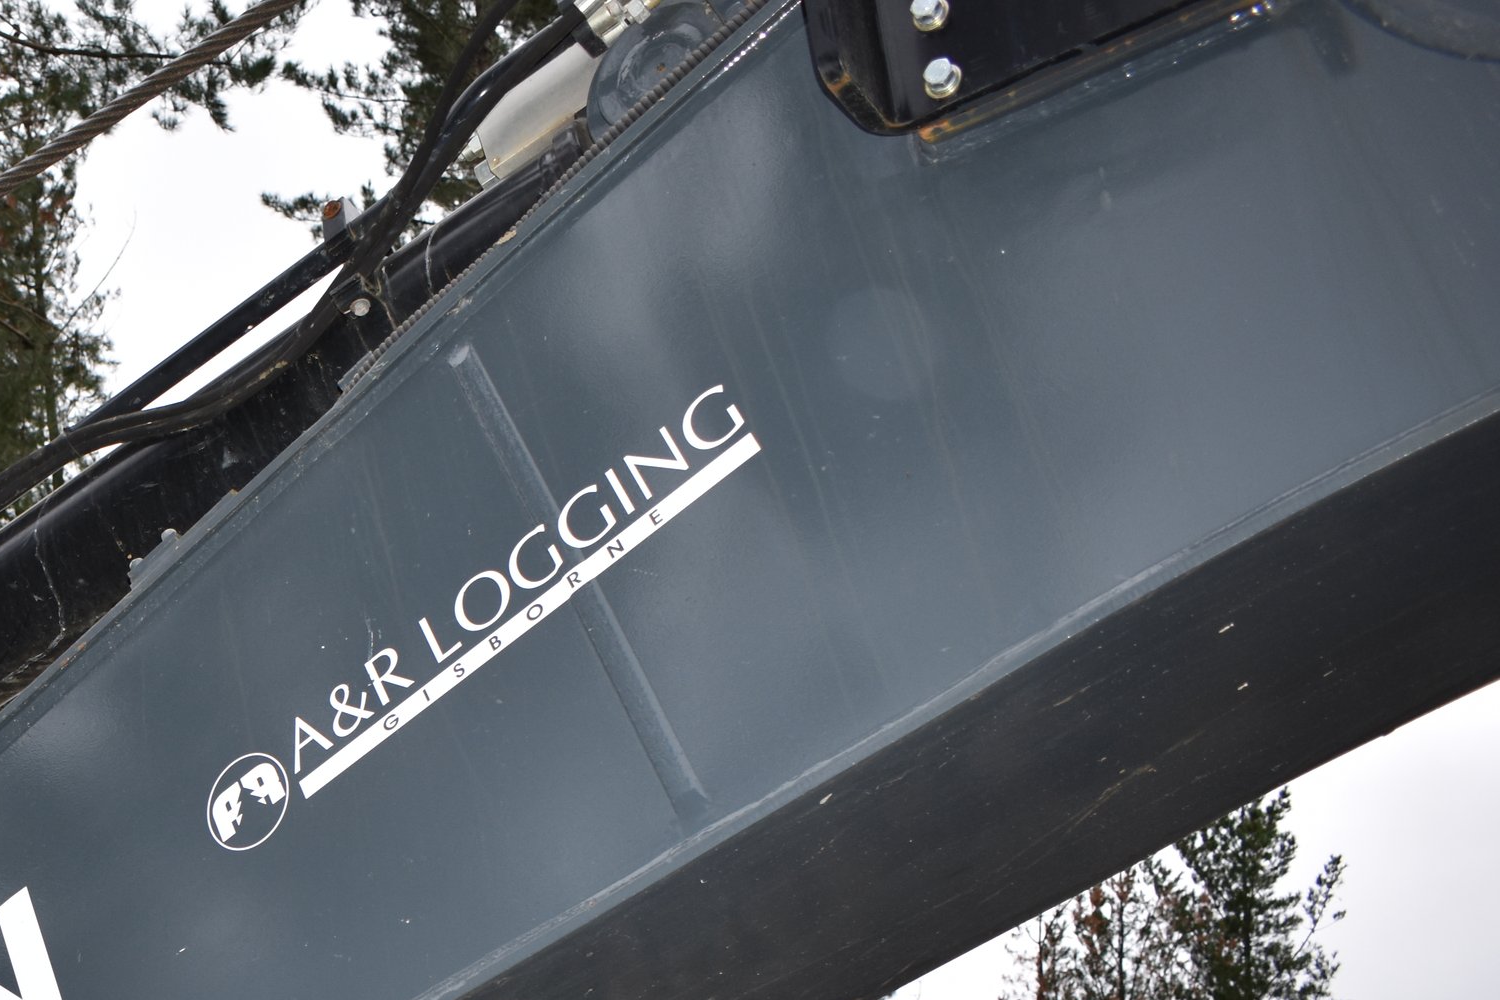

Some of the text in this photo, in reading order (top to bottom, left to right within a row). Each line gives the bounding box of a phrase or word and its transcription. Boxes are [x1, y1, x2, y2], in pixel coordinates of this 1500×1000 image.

[294, 384, 745, 775] A&R LOGGING
[383, 509, 663, 731] GISBORNE
